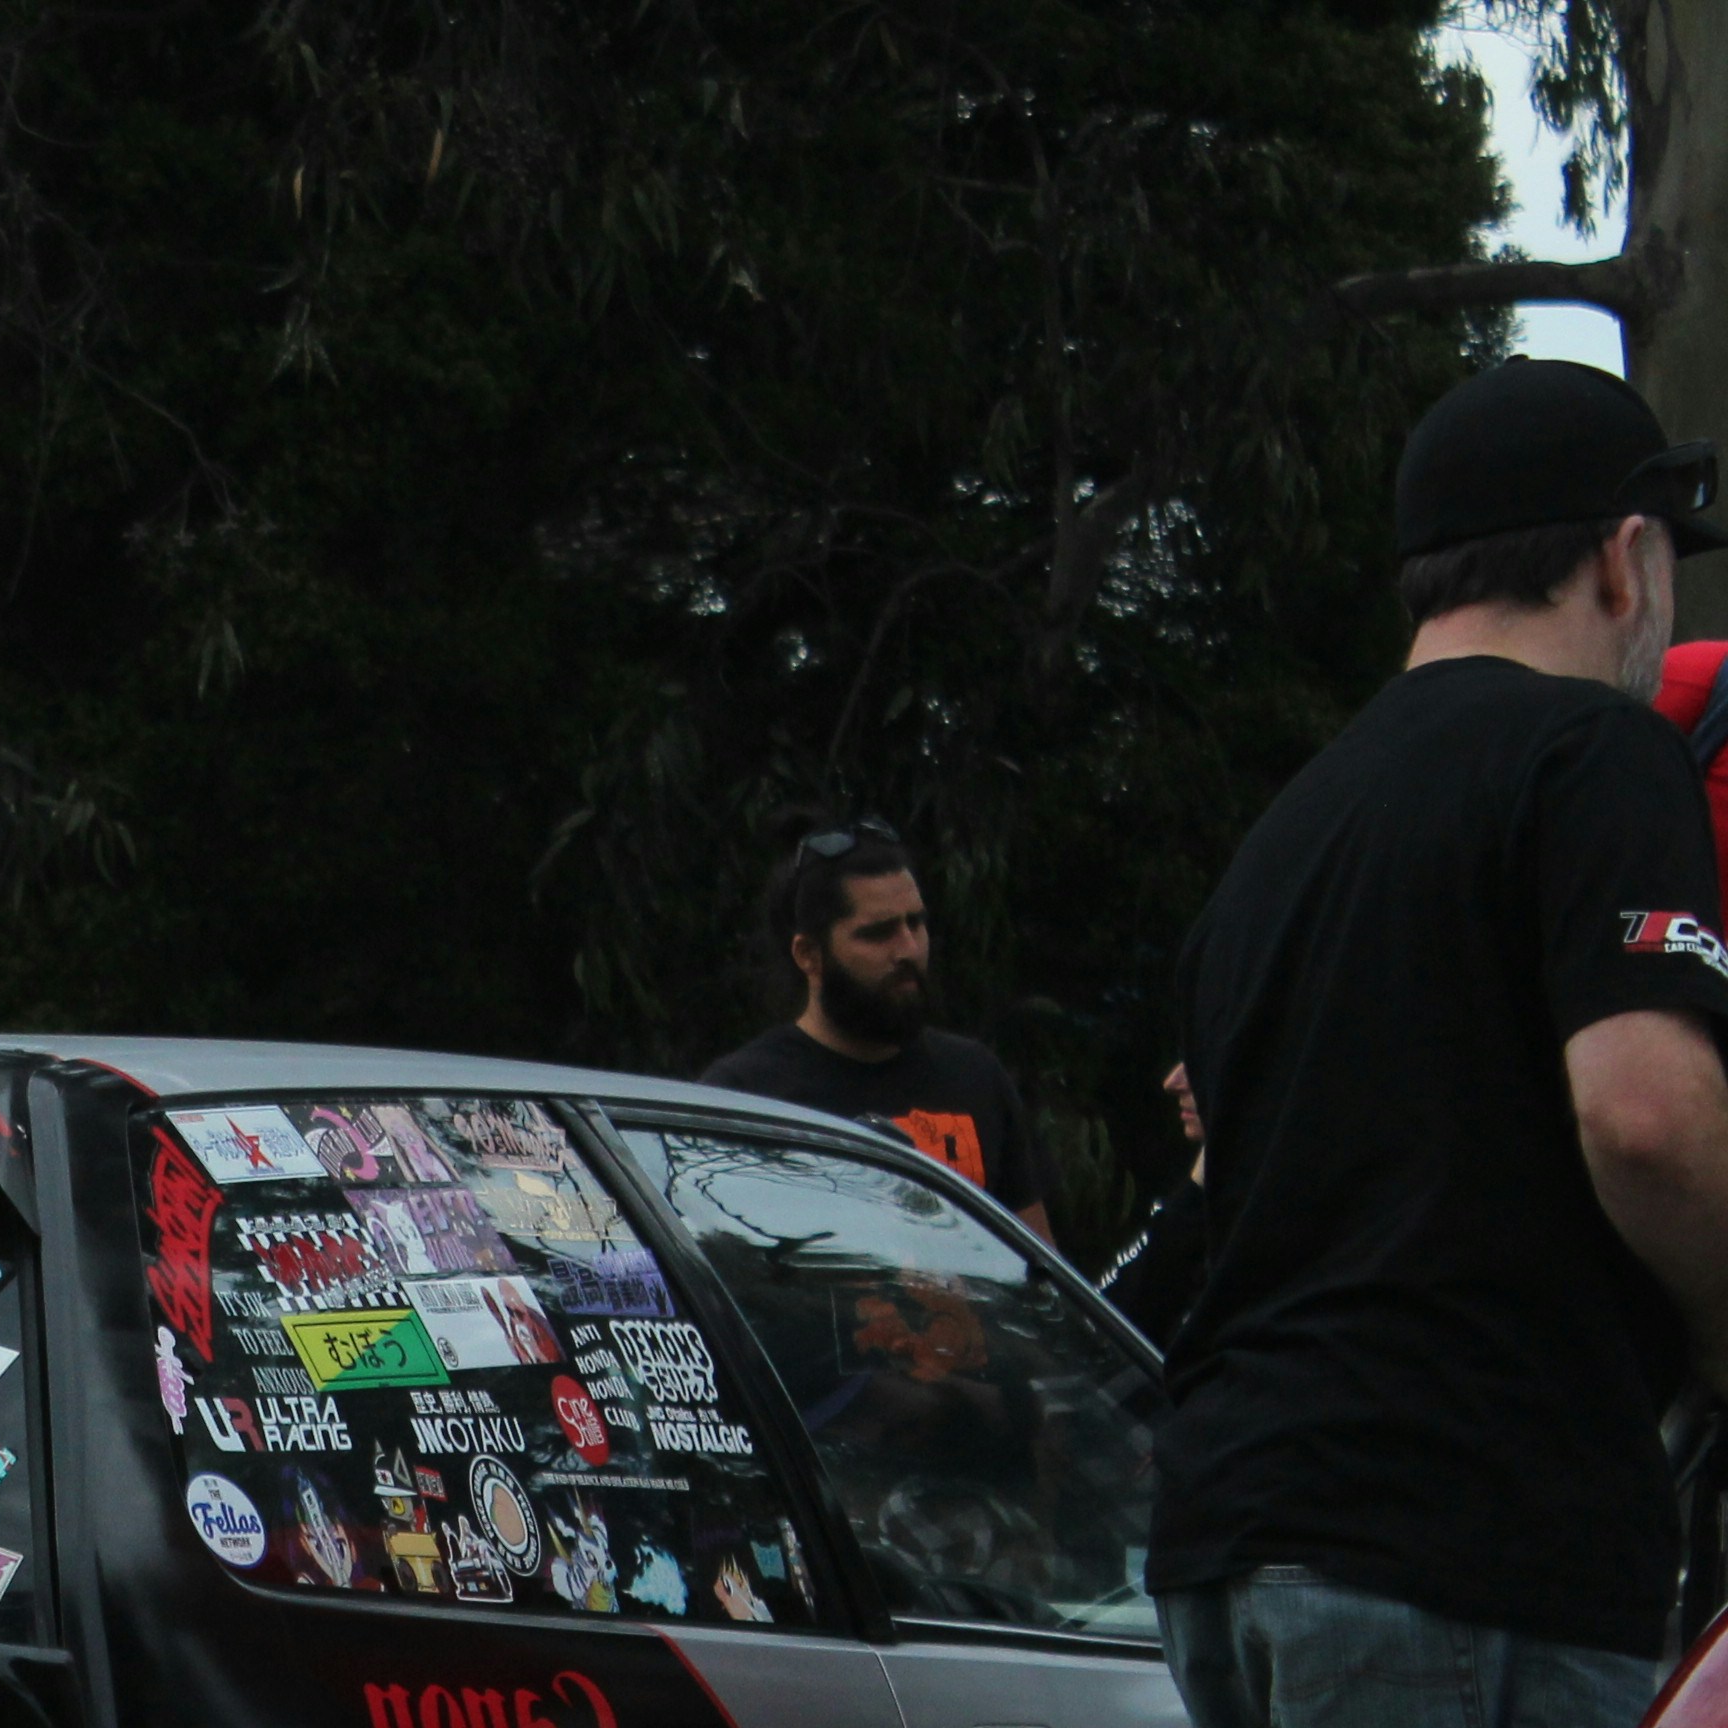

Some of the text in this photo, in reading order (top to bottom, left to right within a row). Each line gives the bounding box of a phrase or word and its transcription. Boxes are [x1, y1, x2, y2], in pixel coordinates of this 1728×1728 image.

[241, 1291, 273, 1318] OK
[231, 1328, 295, 1355] TO FEEL
[324, 1327, 408, 1371] むぼう
[570, 1323, 602, 1349] ANTI
[575, 1349, 622, 1375] HONDA
[252, 1366, 317, 1395] ANXIOUS
[586, 1375, 635, 1401] HONDA
[255, 1396, 341, 1425] ULTRA
[603, 1406, 641, 1432] CLUB
[262, 1422, 353, 1452] RACING
[649, 1421, 754, 1455] NOSTALGIC
[190, 1501, 262, 1540] Fellas
